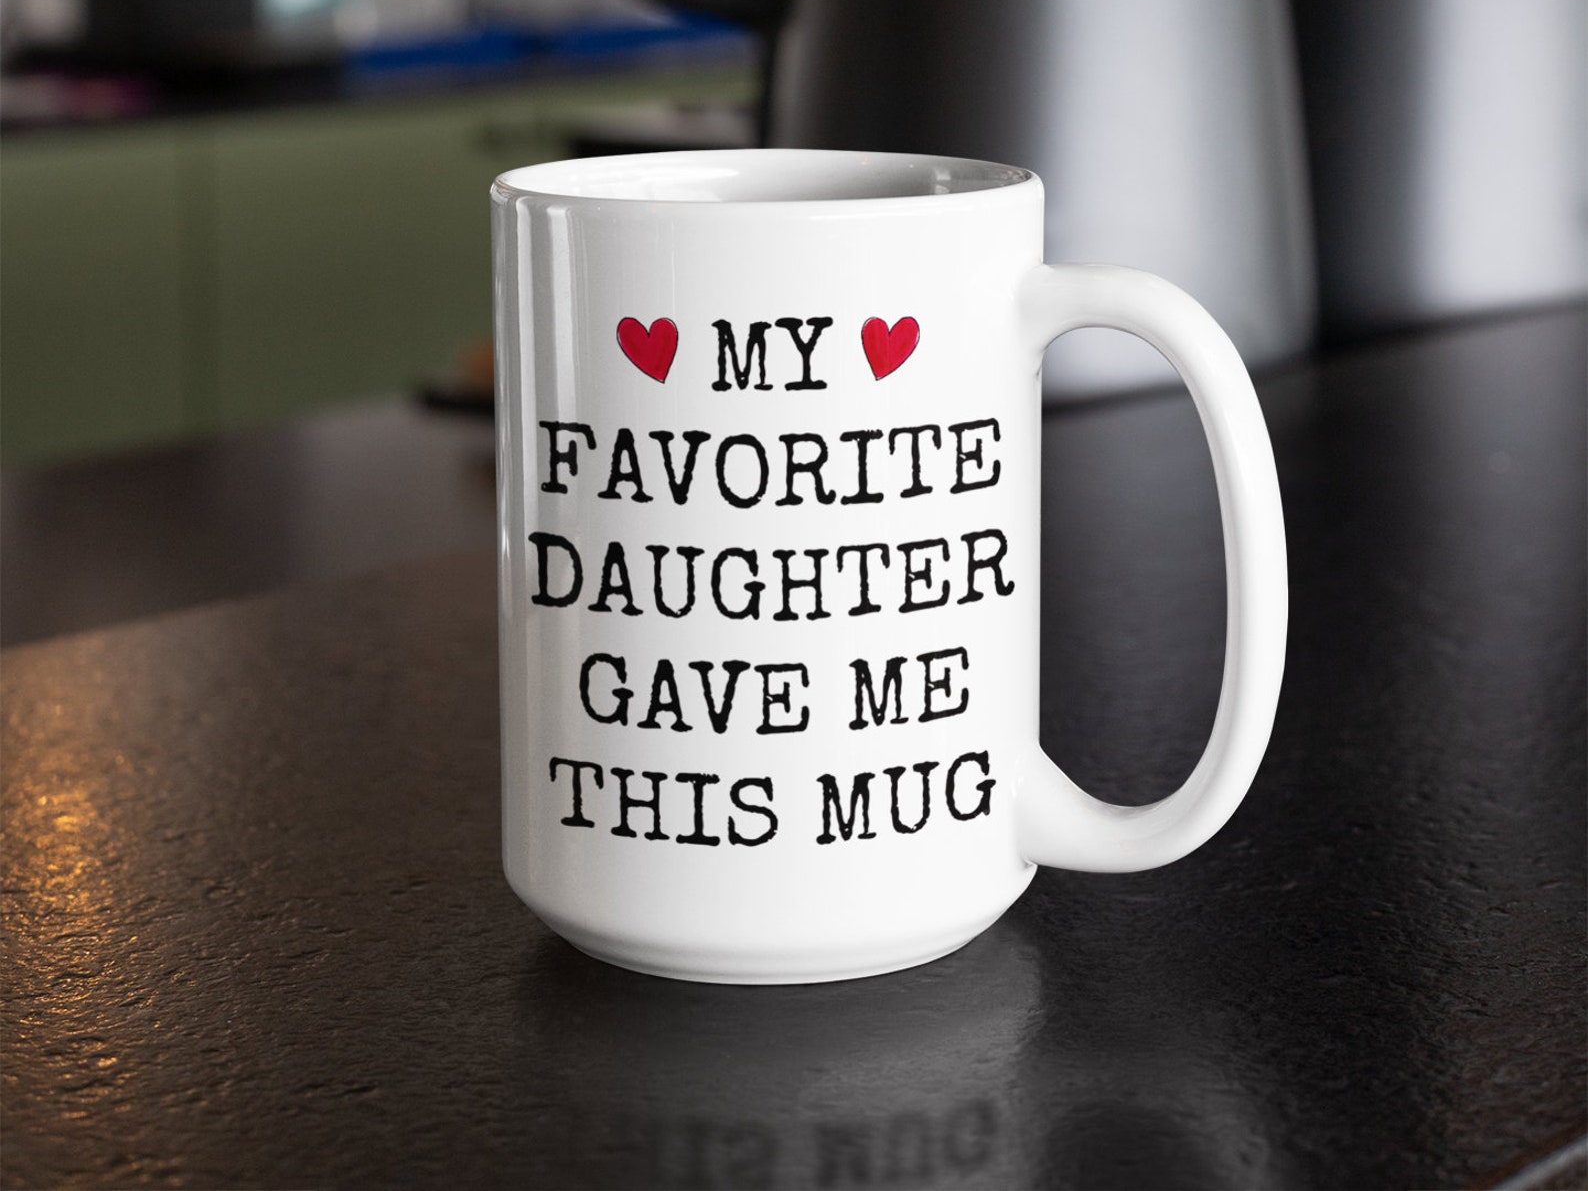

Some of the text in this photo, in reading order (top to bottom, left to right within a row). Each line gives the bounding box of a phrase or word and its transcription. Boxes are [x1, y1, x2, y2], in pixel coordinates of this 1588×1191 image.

[711, 317, 833, 391] MY
[539, 418, 1001, 508] FAVORITE
[528, 529, 1015, 621] DAUGHTER
[579, 647, 970, 734] GAVE ME
[549, 751, 996, 846] THIS MUG
